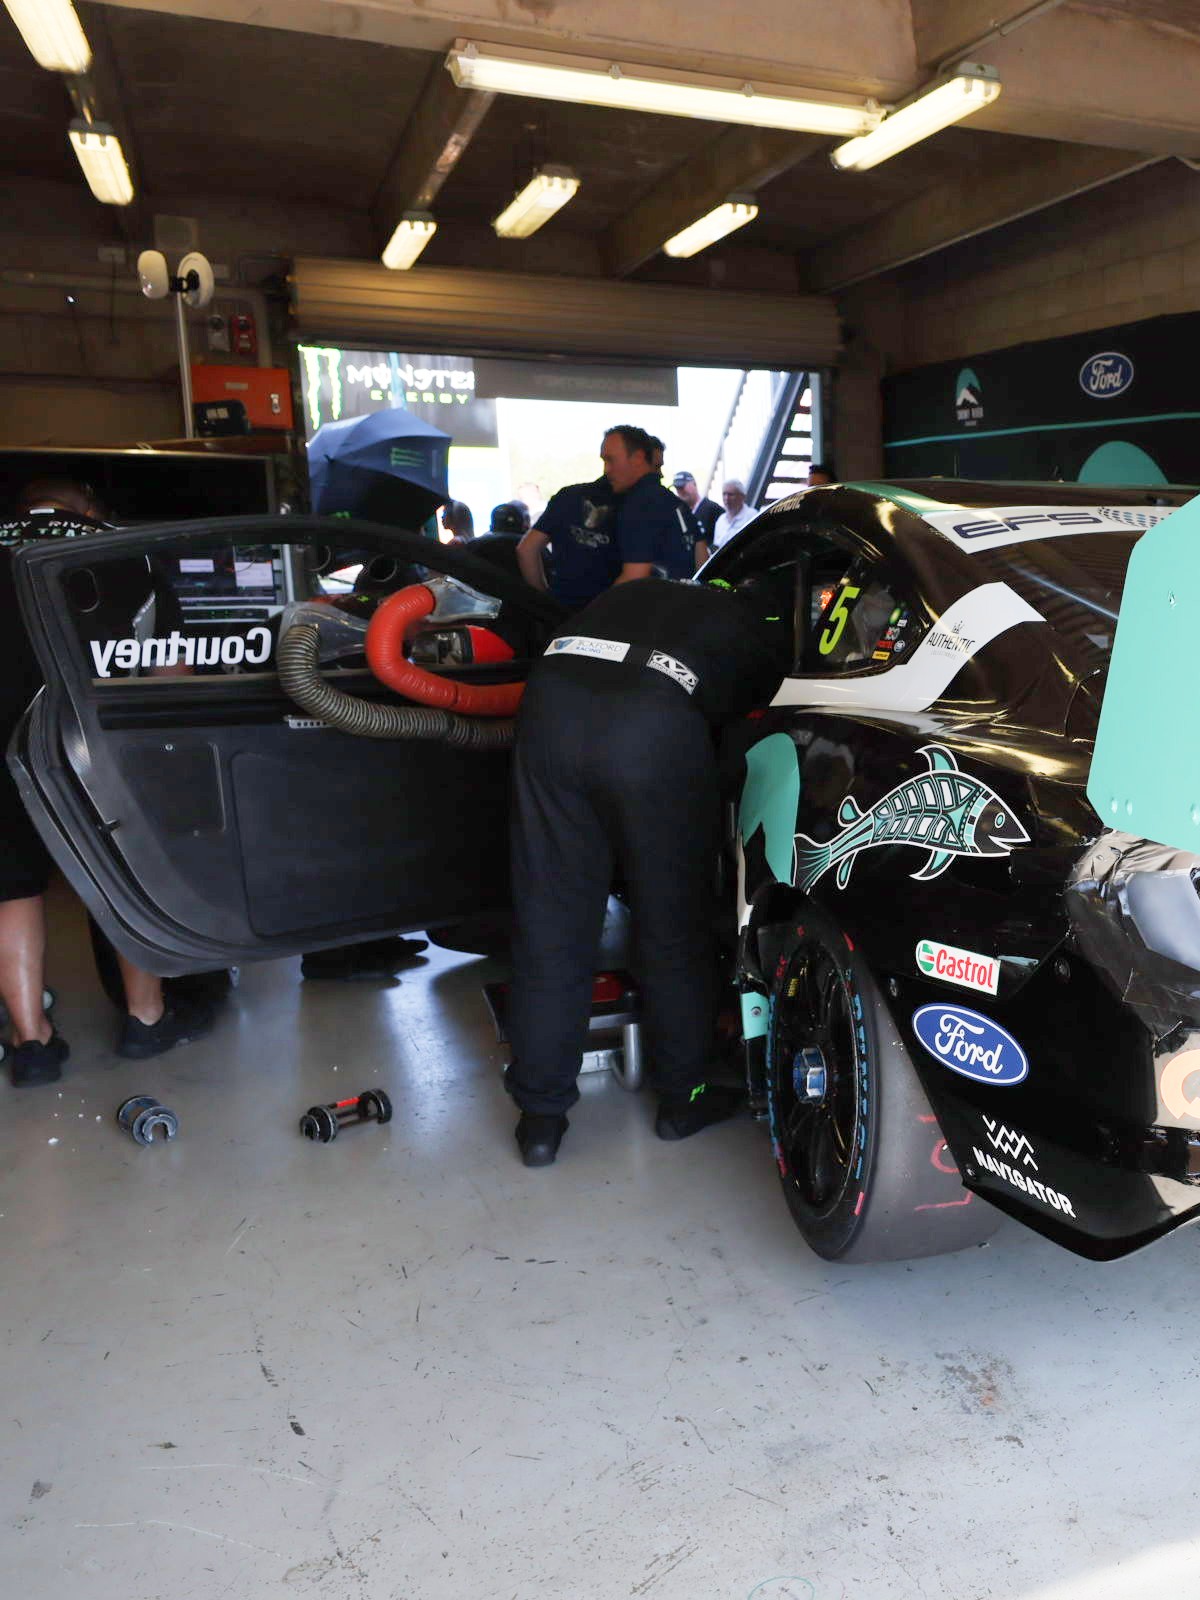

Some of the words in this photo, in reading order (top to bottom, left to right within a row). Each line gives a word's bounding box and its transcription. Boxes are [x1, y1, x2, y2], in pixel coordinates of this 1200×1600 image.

[1090, 359, 1123, 391] Ford
[370, 389, 468, 405] EERGY
[953, 512, 1103, 539] EFS
[818, 586, 861, 656] 5
[926, 632, 976, 654] AUTHENTIC
[935, 948, 994, 989] Castrol
[934, 1013, 1004, 1075] Ford
[972, 1146, 1077, 1219] NAVIGATOR
